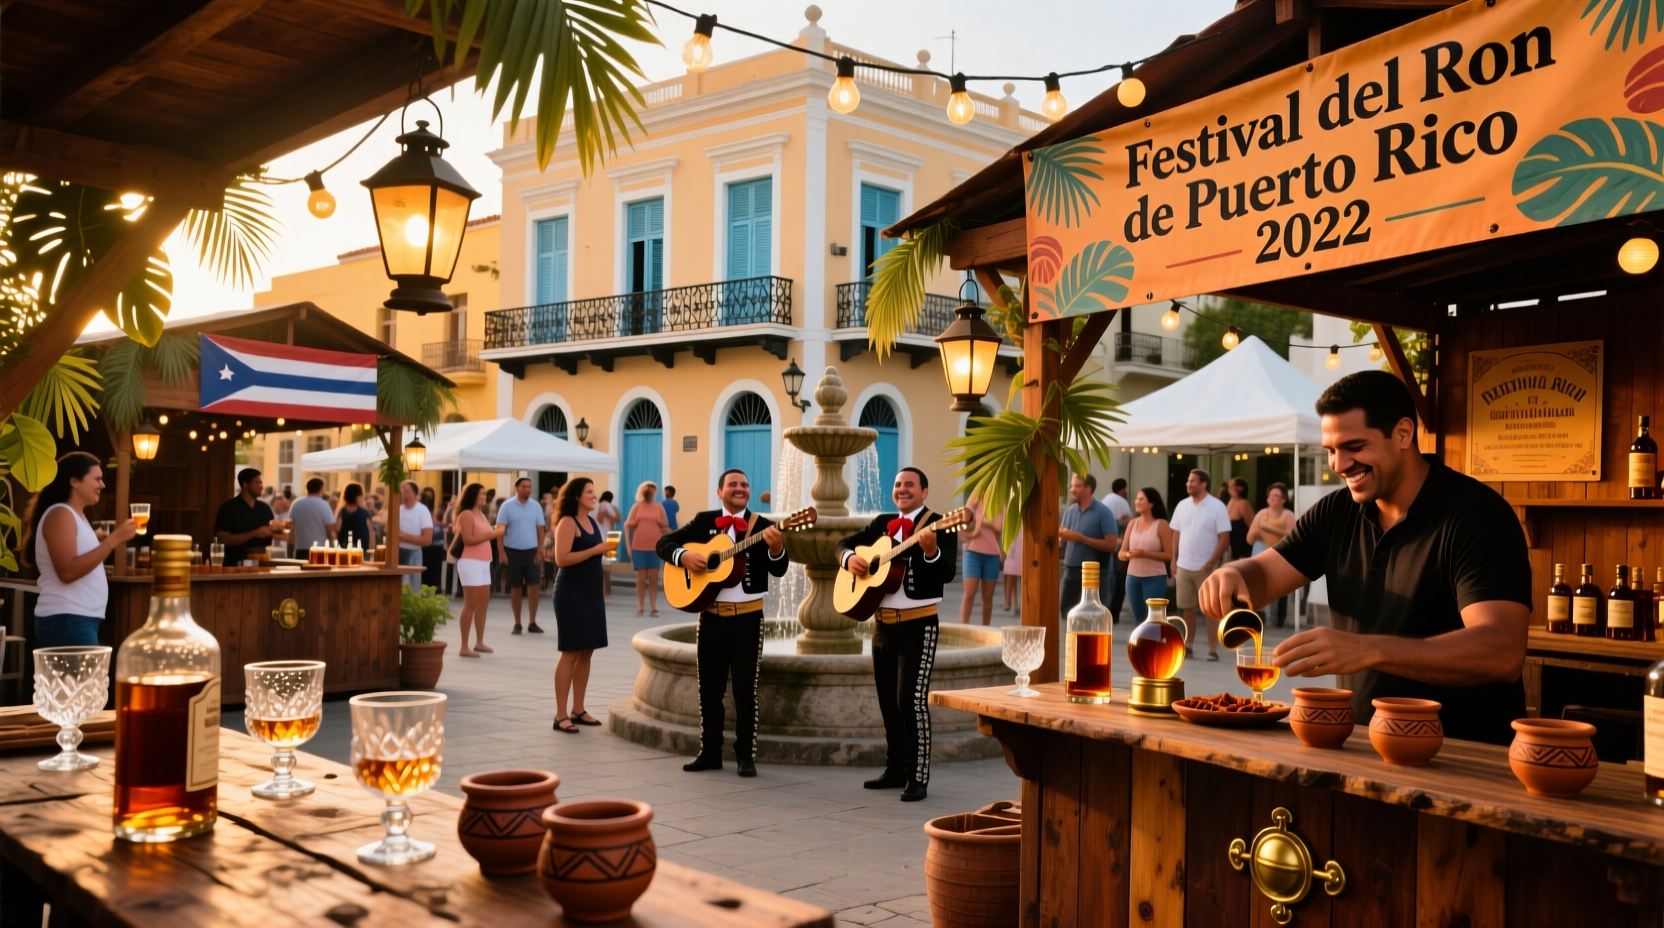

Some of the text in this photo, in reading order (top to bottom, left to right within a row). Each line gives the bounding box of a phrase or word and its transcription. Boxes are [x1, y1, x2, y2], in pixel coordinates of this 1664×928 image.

[1124, 26, 1557, 189] Festival del Ron
[1124, 111, 1518, 243] de Puerto Rico
[1255, 199, 1372, 265] 2022
